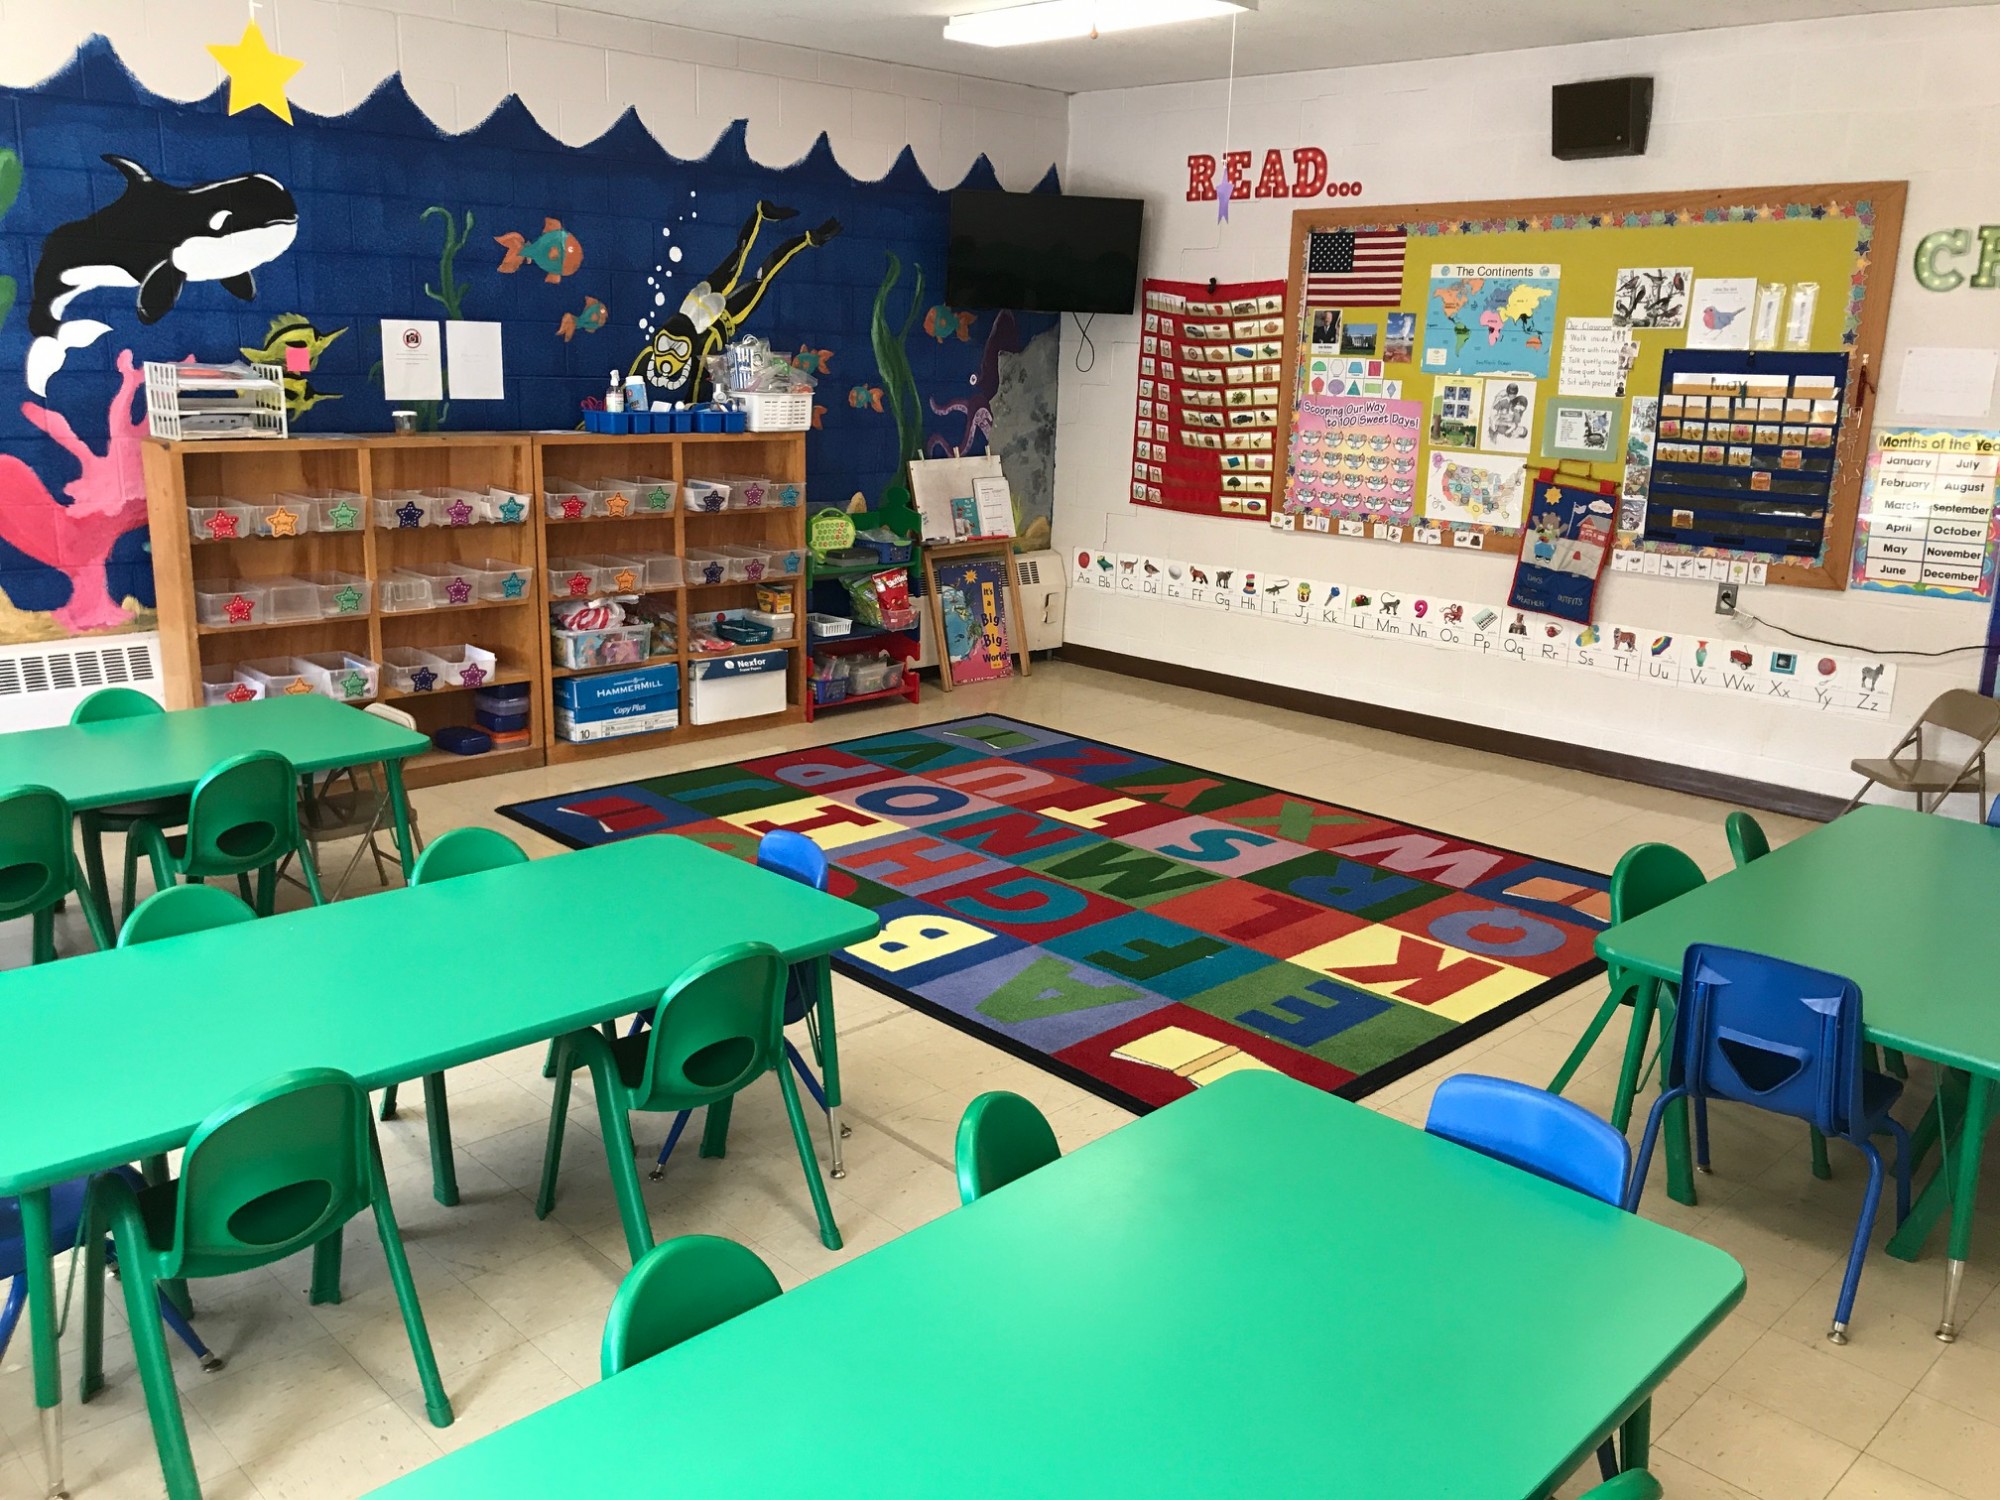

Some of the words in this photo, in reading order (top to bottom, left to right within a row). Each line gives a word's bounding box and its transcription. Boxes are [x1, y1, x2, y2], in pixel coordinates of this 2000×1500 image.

[1456, 266, 1475, 277] The
[1477, 266, 1534, 278] Continents
[1149, 316, 1155, 331] 2
[1147, 338, 1153, 352] 3
[1145, 360, 1152, 374] 4
[1142, 381, 1149, 395] 5
[1710, 377, 1749, 408] May
[1142, 401, 1149, 416] 6
[1304, 401, 1344, 417] Scooping
[1345, 404, 1364, 414] Our
[1365, 402, 1386, 414] Way
[1327, 419, 1337, 427] to
[1339, 416, 1357, 427] 100
[1359, 415, 1389, 425] Sweet
[1391, 413, 1419, 429] Days!
[1141, 423, 1149, 436] 7
[1140, 443, 1147, 457] 8
[1879, 435, 1928, 449] Months
[1931, 438, 1946, 450] of
[1949, 438, 1971, 451] the
[1136, 464, 1143, 479] 9
[1886, 456, 1932, 468] January
[1956, 459, 1980, 471] July
[1134, 485, 1144, 499] 10
[1881, 478, 1930, 491] February
[1944, 482, 1985, 494] August
[1884, 500, 1920, 511] March
[1933, 503, 1990, 516] September
[1886, 523, 1912, 533] April
[1933, 525, 1982, 538] October
[1883, 543, 1909, 555] May
[1927, 547, 1982, 561] November
[1526, 573, 1543, 583] DAYS
[1880, 564, 1907, 576] June
[1924, 568, 1979, 582] December
[981, 613, 1000, 627] Big
[983, 634, 1003, 648] Big
[1077, 571, 1090, 584] Aa
[1098, 576, 1111, 588] Bb
[1121, 577, 1134, 591] Cc
[1143, 581, 1157, 594] Dd
[1168, 585, 1180, 598] Ee
[1191, 588, 1203, 601] Ff
[1215, 592, 1230, 611] Gg
[1240, 594, 1256, 610] Hh
[1272, 601, 1279, 614] Ii
[1295, 605, 1309, 624] Jj
[1323, 609, 1337, 623] Kk
[1353, 614, 1365, 629] Ll
[1376, 618, 1399, 634] Mm
[1410, 622, 1428, 638] Nn
[1440, 628, 1459, 643] Oo
[1473, 633, 1490, 653] Pp
[1504, 638, 1526, 661] Qq
[1542, 644, 1559, 660] Rr
[1578, 650, 1594, 666] Ss
[1614, 655, 1629, 672] Tt
[1649, 662, 1669, 680] Uu
[1690, 668, 1707, 685] Vv
[1722, 672, 1755, 692] Ww
[1768, 680, 1790, 698] Xx
[1814, 686, 1832, 710] Yy
[1856, 692, 1879, 712] Zz
[737, 657, 767, 668] Nexfor
[982, 651, 1008, 663] World
[613, 705, 631, 715] Copy
[632, 703, 647, 713] Plus
[580, 729, 591, 740] 10
[775, 763, 889, 787] P
[923, 766, 1054, 797] U
[855, 786, 969, 816] O
[1036, 797, 1147, 829] T
[1228, 800, 1370, 843] X
[1156, 828, 1277, 863] S
[836, 837, 988, 886] H
[1288, 860, 1426, 913] R
[944, 877, 1088, 925] G
[1220, 894, 1325, 942] L
[844, 914, 998, 972] B
[1082, 931, 1233, 981] F
[1325, 935, 1505, 1006] K
[976, 955, 1150, 1024] A
[1233, 979, 1397, 1048] E
